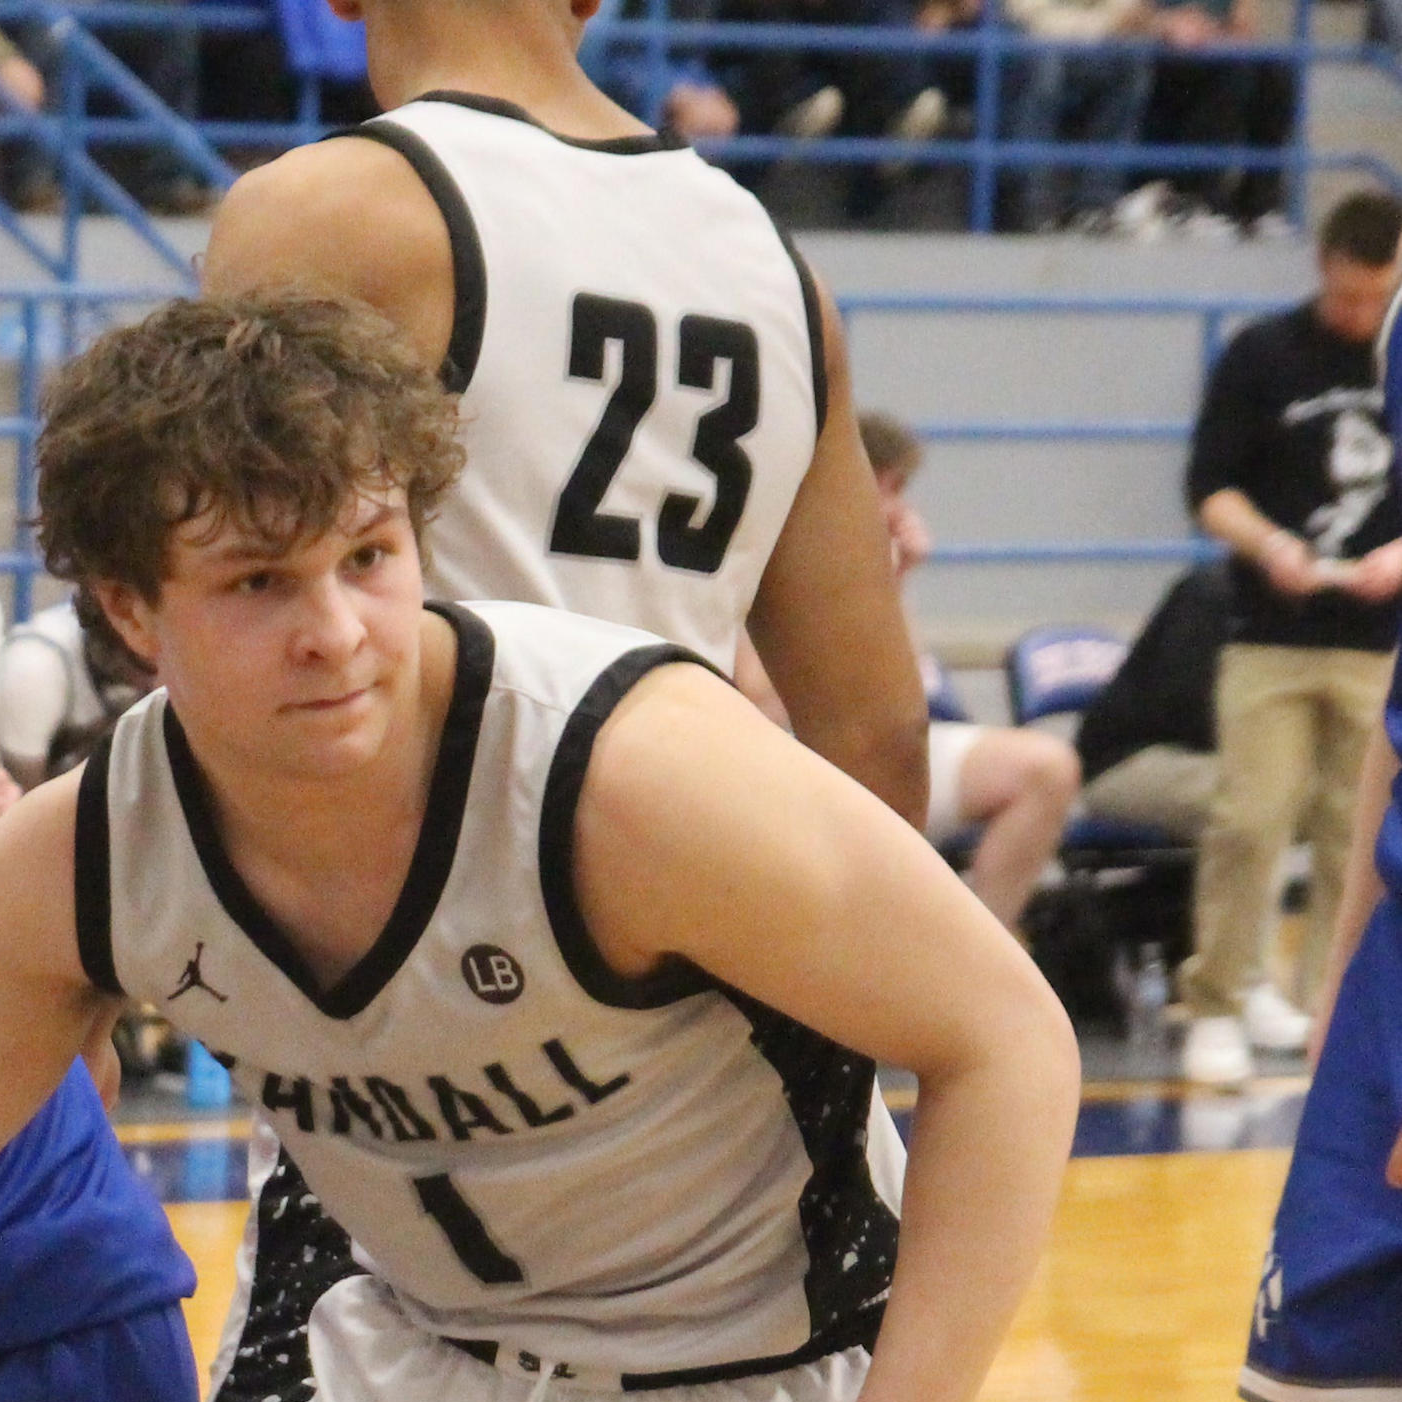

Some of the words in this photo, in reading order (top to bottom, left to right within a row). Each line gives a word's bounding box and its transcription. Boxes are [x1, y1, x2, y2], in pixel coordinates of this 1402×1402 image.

[547, 291, 760, 574] 23
[467, 954, 520, 994] LB
[210, 1037, 632, 1142] ANDALL
[413, 1172, 525, 1285] 1
